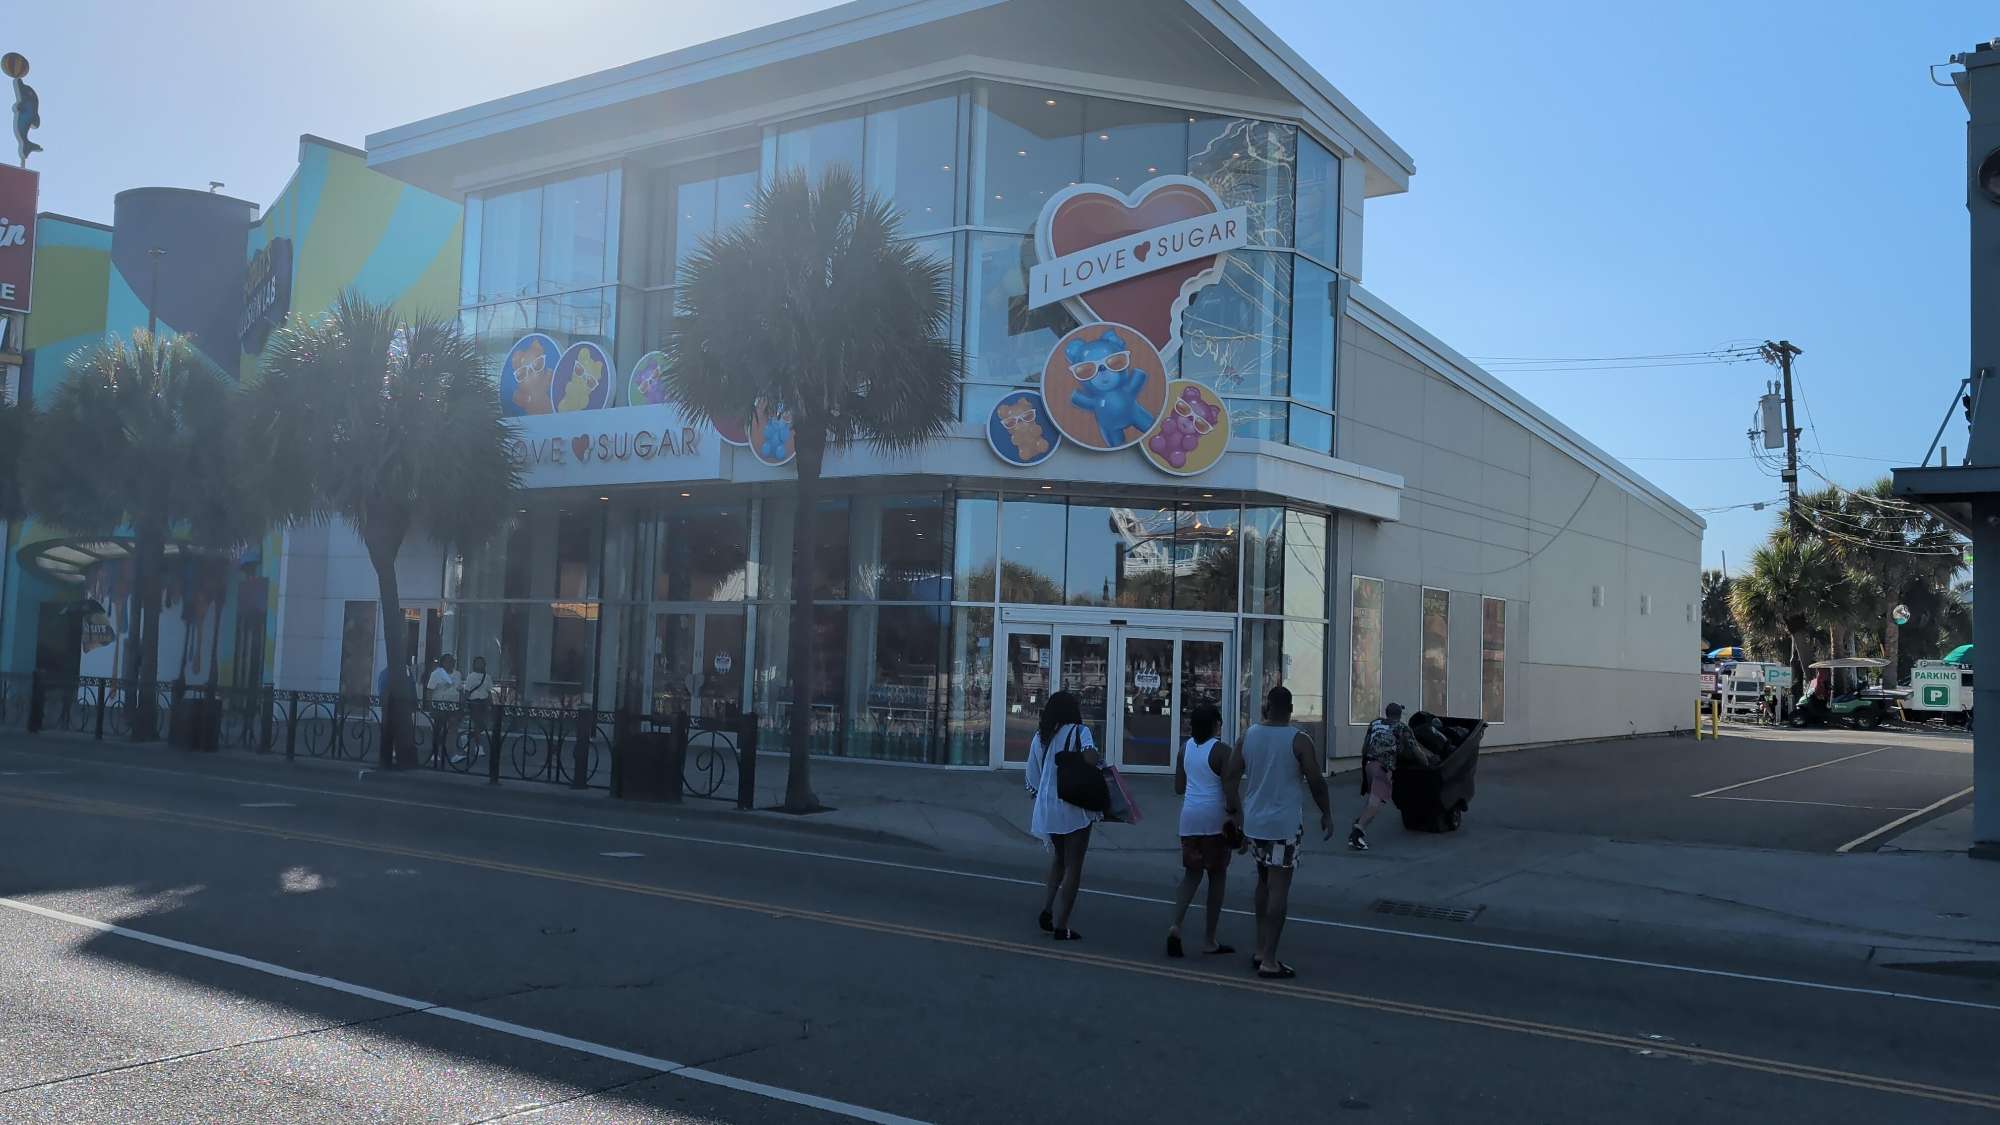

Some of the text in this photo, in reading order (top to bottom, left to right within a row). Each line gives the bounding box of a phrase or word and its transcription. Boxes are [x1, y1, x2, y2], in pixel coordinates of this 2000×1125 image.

[1043, 219, 1237, 293] I LOVE SUGAR
[511, 427, 697, 465] OVE SUGAR
[1768, 669, 1780, 682] P
[1914, 671, 1958, 680] PARKING
[1930, 689, 1943, 702] P
